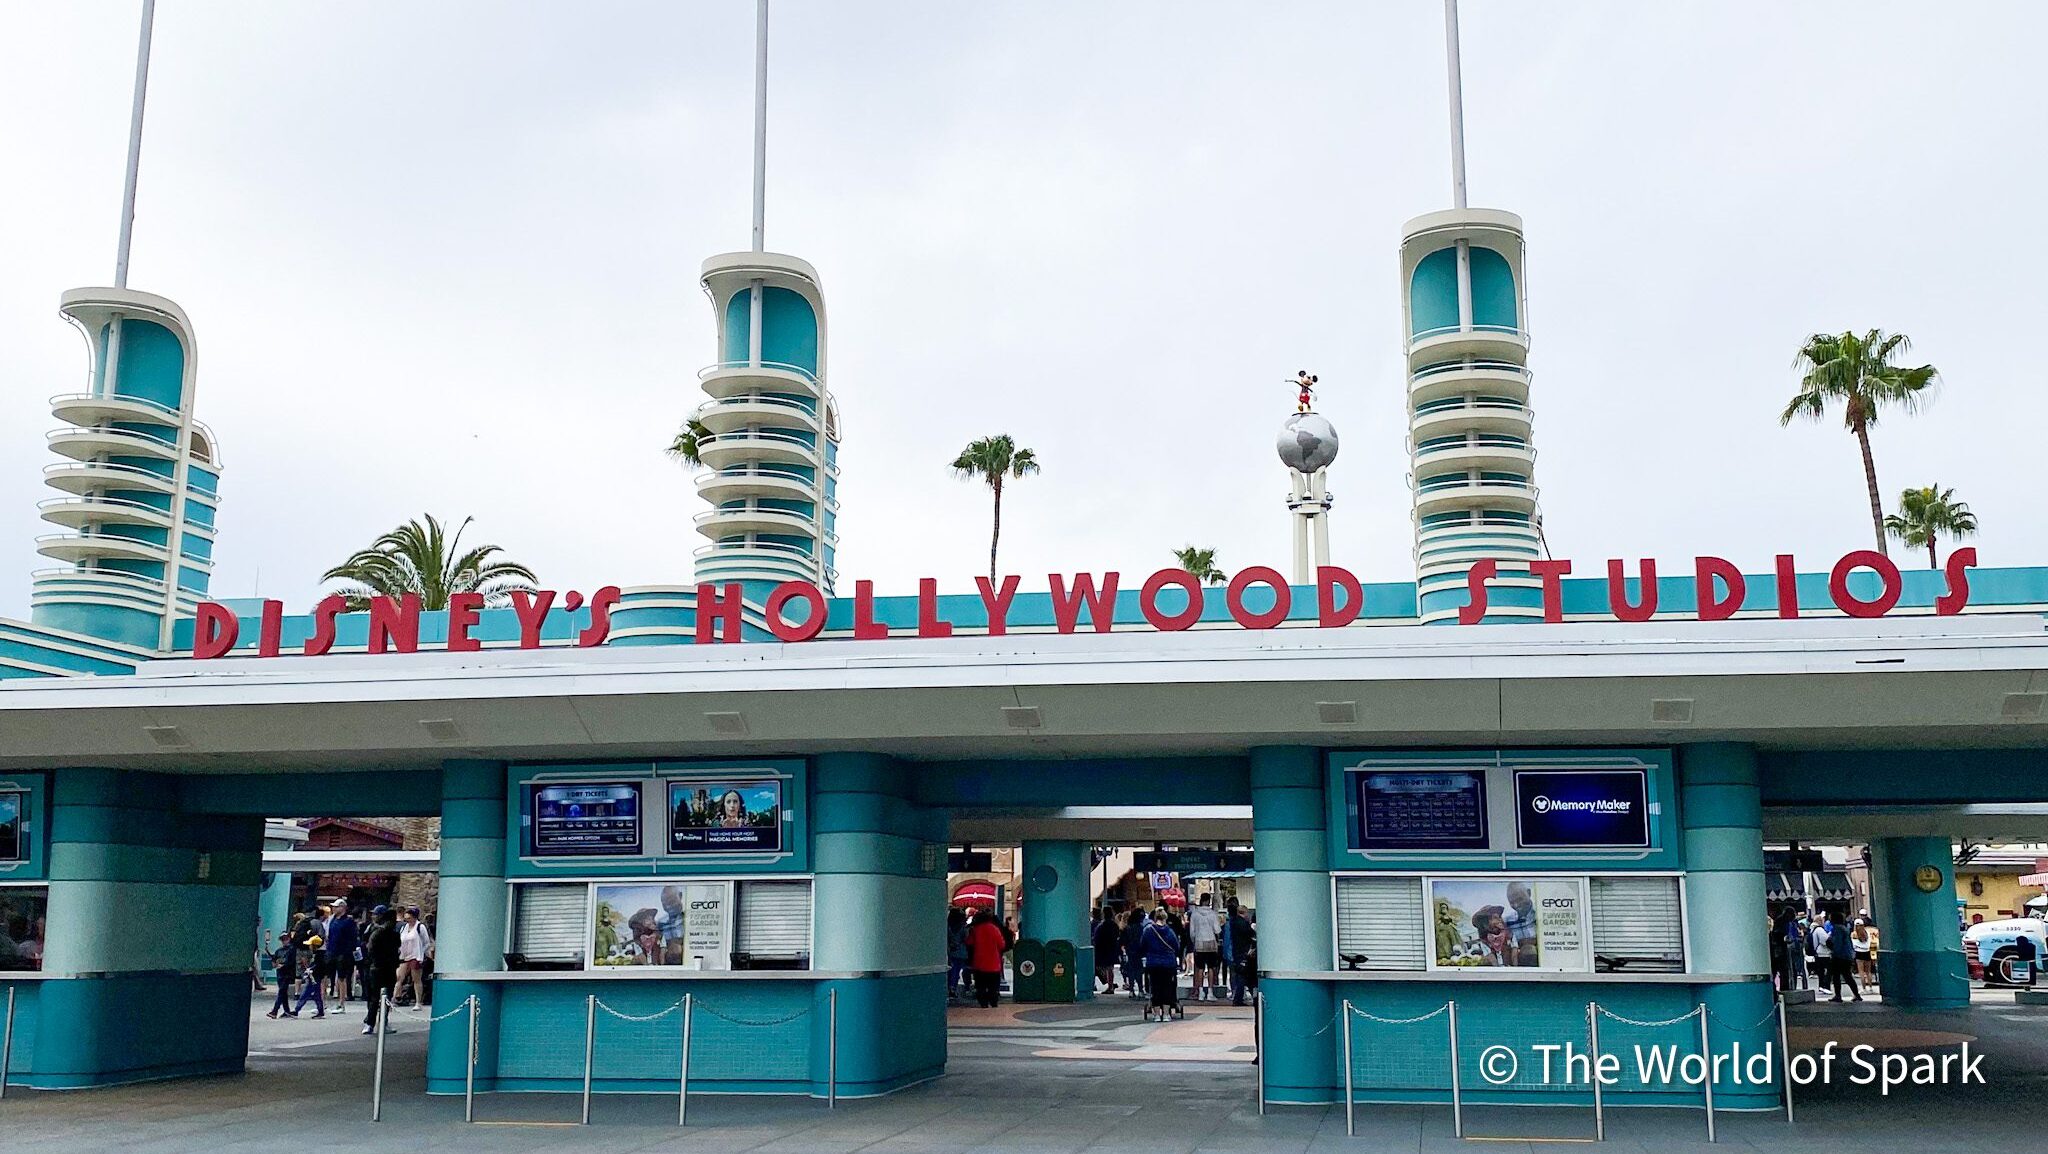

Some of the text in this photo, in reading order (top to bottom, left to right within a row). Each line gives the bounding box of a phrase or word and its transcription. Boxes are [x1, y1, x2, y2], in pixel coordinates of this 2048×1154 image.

[193, 547, 1976, 659] DISNEY'S HOLLYWOOD STUDIOS
[691, 901, 720, 909] EPCOT
[1542, 899, 1575, 907] EPCOT
